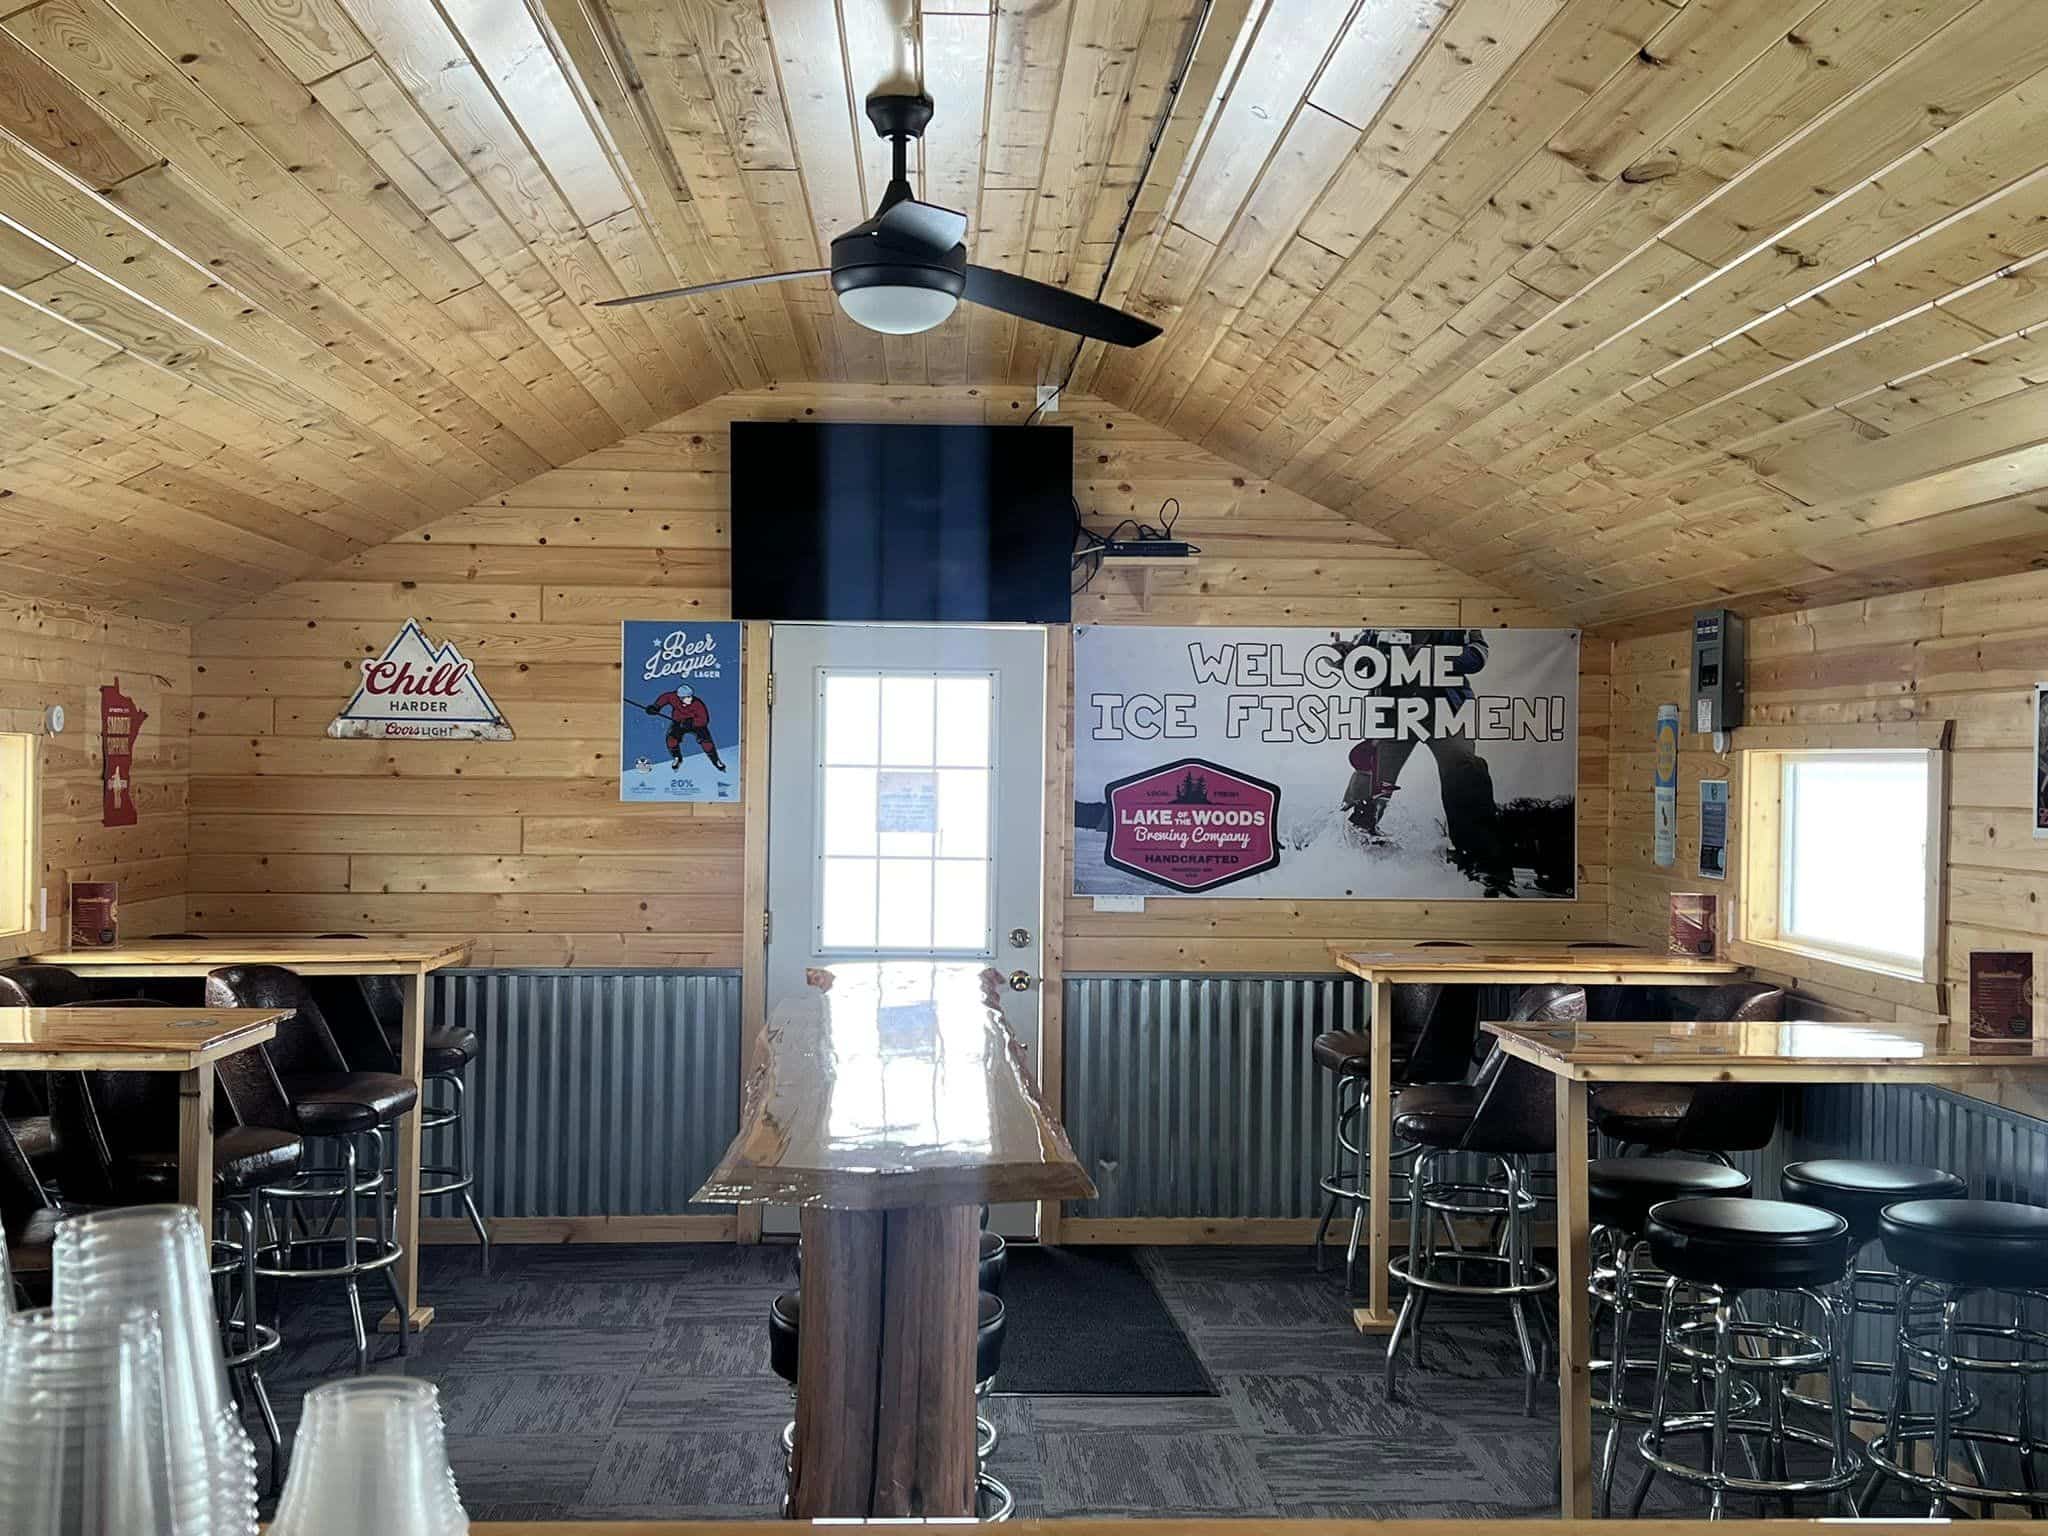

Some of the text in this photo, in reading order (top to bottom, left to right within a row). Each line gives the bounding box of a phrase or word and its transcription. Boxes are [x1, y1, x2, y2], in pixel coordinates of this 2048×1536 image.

[662, 630, 717, 660] Beer
[643, 649, 717, 680] League
[694, 670, 721, 678] LAGER
[1188, 643, 1464, 691] WELCOME
[365, 661, 468, 696] Chill
[389, 701, 448, 713] HARDER
[384, 721, 454, 737] Coors LIGHT
[1091, 694, 1566, 744] ICE FISHERMEN!
[670, 779, 695, 788] 20%
[1121, 809, 1173, 825] LAKE
[1174, 818, 1192, 826] THE
[1191, 809, 1265, 826] WOODS
[1134, 826, 1251, 849] Brewing Company
[1144, 854, 1240, 865] HANDCRAFTED
